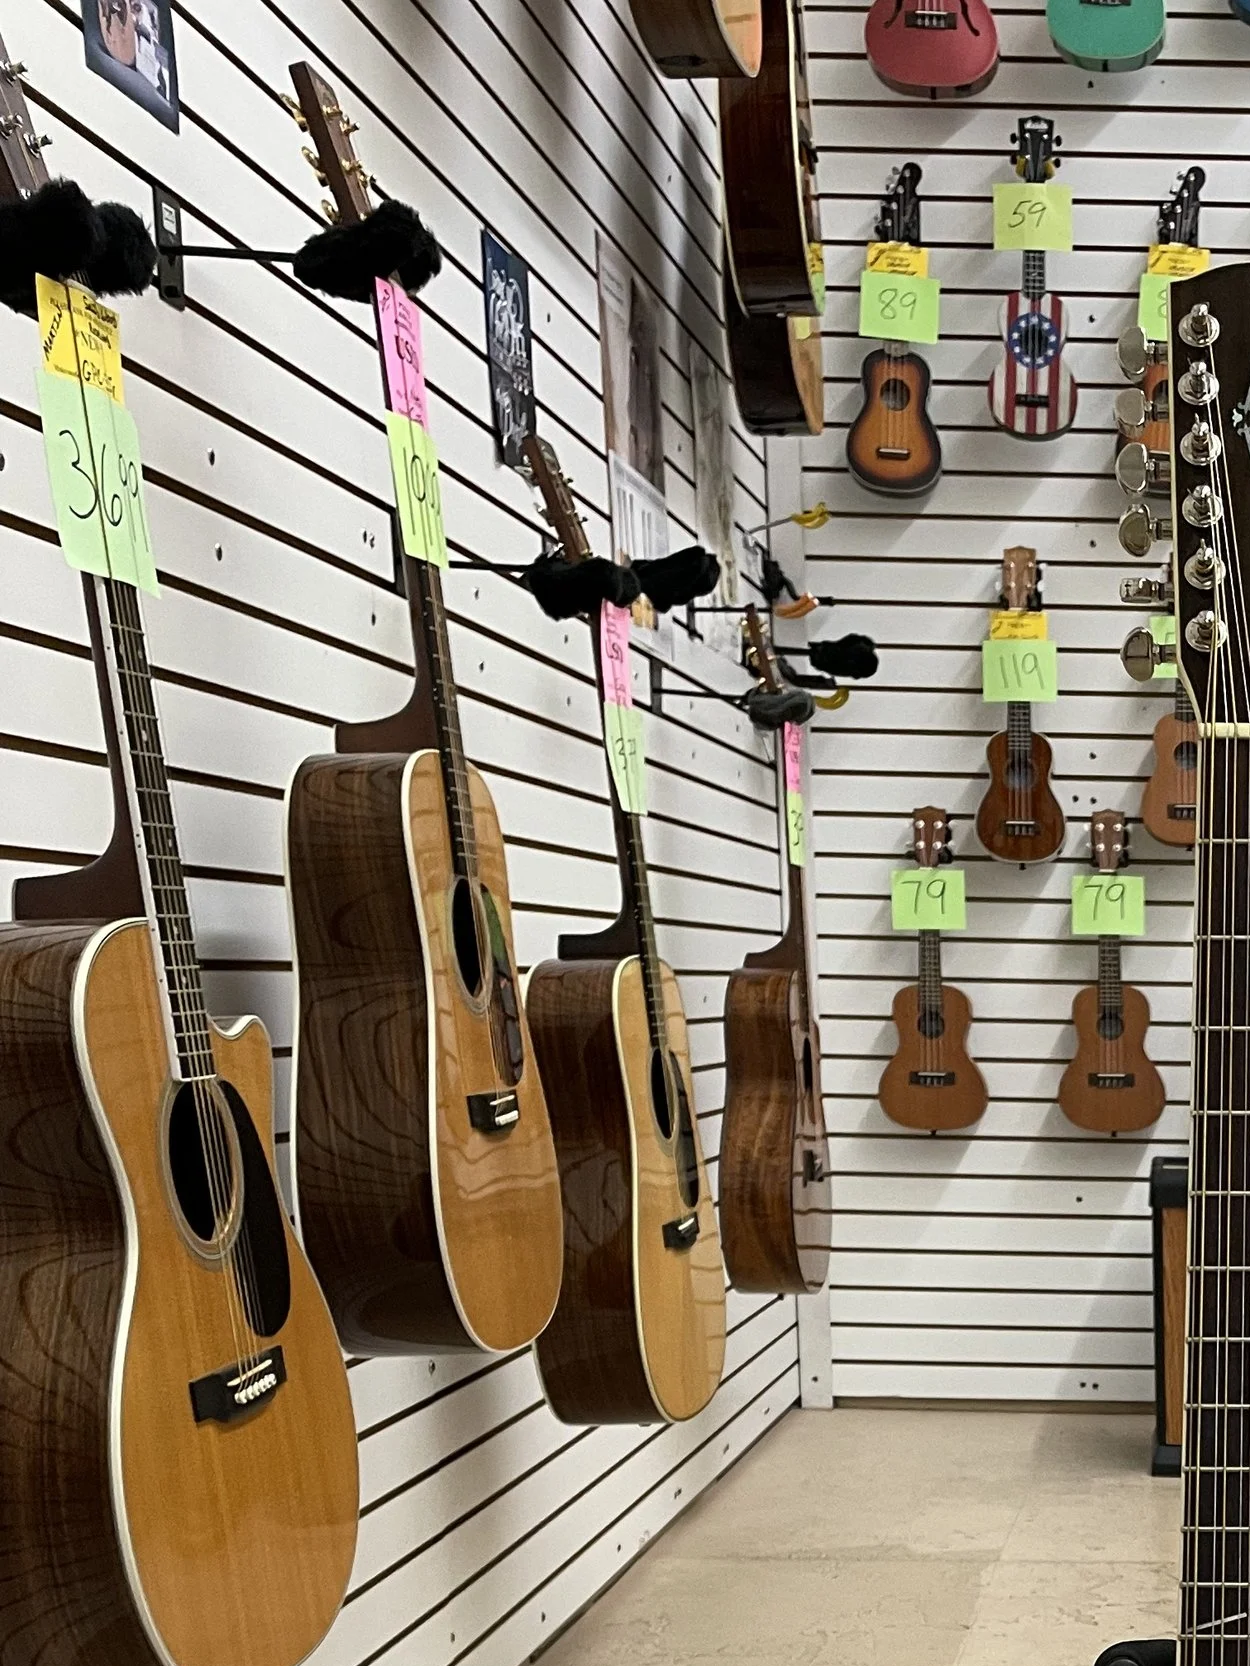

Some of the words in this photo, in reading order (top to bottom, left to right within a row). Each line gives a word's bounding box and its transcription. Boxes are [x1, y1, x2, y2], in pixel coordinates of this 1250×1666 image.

[1008, 200, 1047, 228] 59
[878, 288, 918, 320] 89
[58, 429, 149, 553] 3699
[1000, 652, 1045, 689] 119
[901, 879, 947, 915] 79
[1083, 883, 1126, 920] 79
